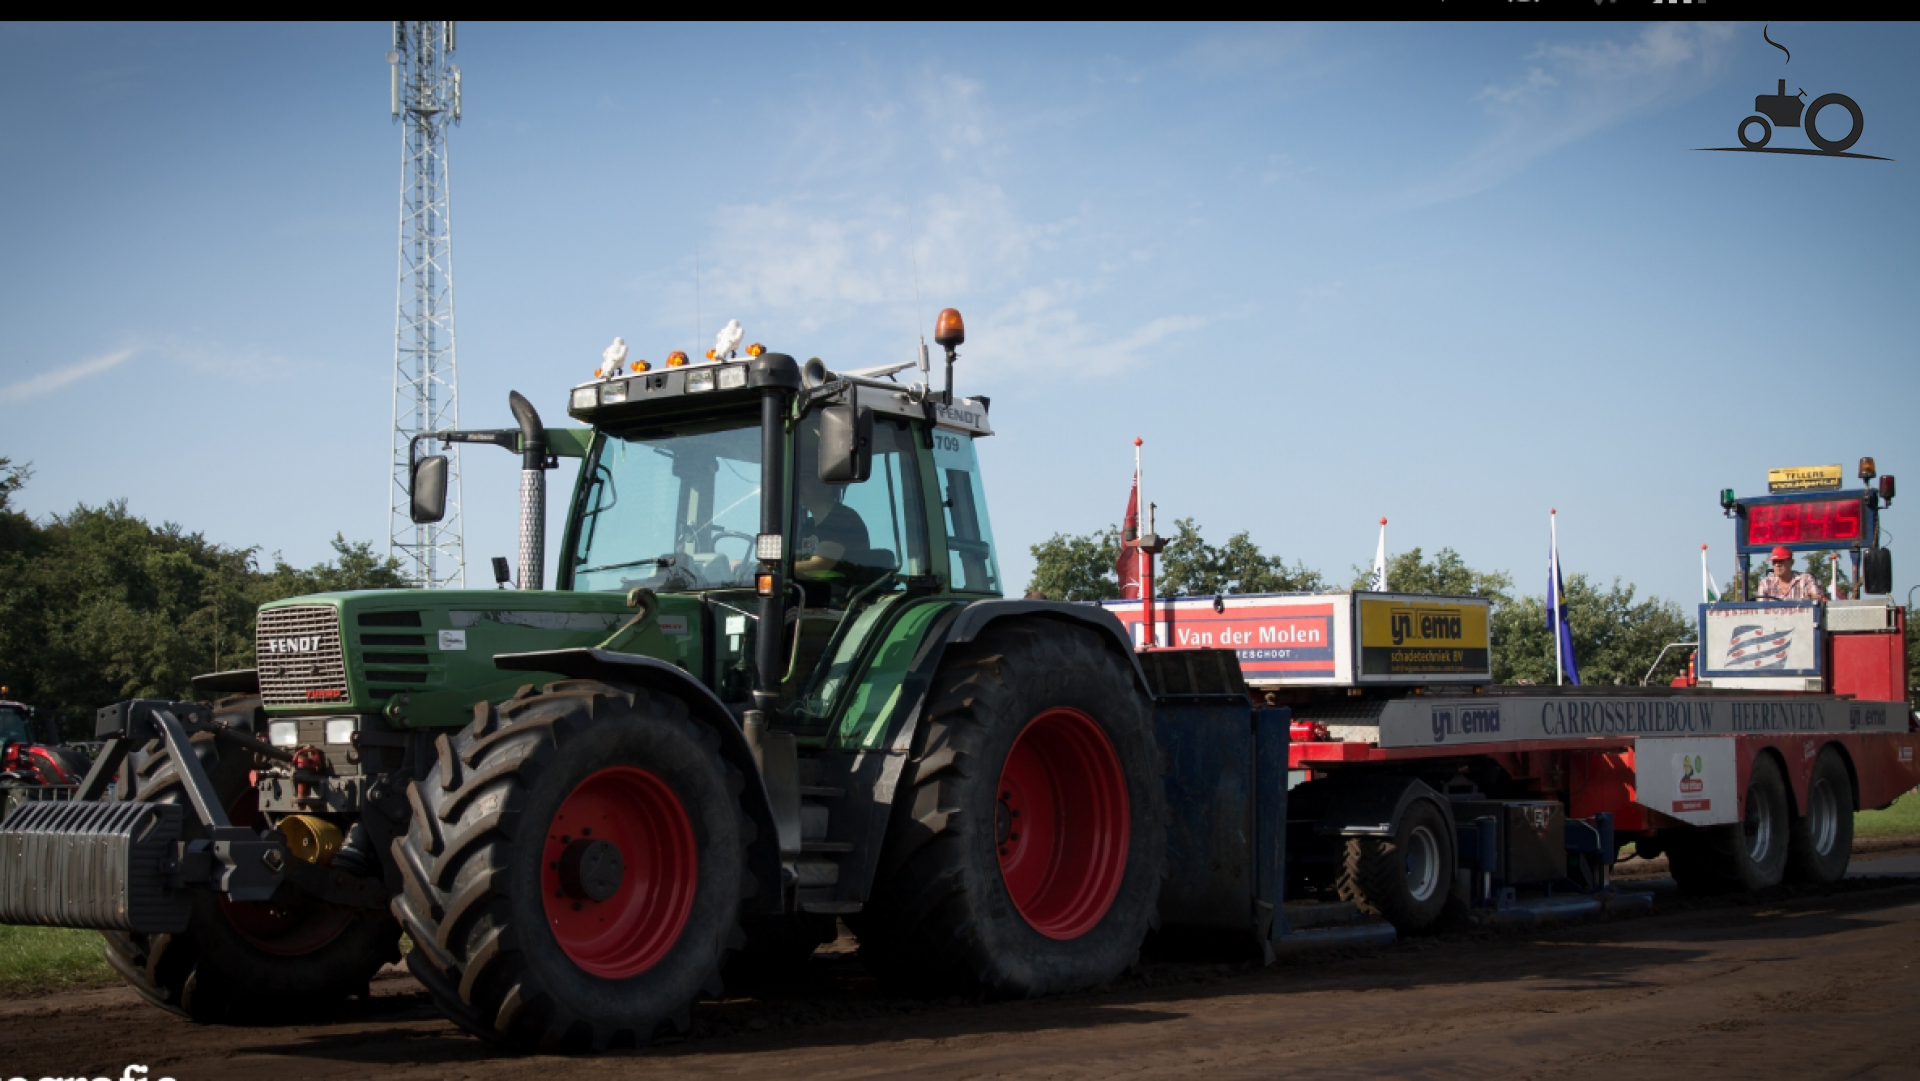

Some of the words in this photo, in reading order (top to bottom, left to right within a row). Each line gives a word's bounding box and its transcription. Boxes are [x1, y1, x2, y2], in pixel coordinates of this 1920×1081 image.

[937, 404, 982, 428] FENDT
[935, 436, 959, 452] 709
[1178, 628, 1213, 645] Van
[1220, 627, 1252, 645] der
[1259, 624, 1320, 643] Molen
[269, 635, 322, 653] FENDT
[1391, 649, 1451, 662] schadetechniek
[1453, 650, 1463, 662] BV
[306, 689, 341, 698] TURBO
[1542, 701, 1714, 735] CARROSSERIEBOUW
[1732, 702, 1825, 731] HEERENVEEN
